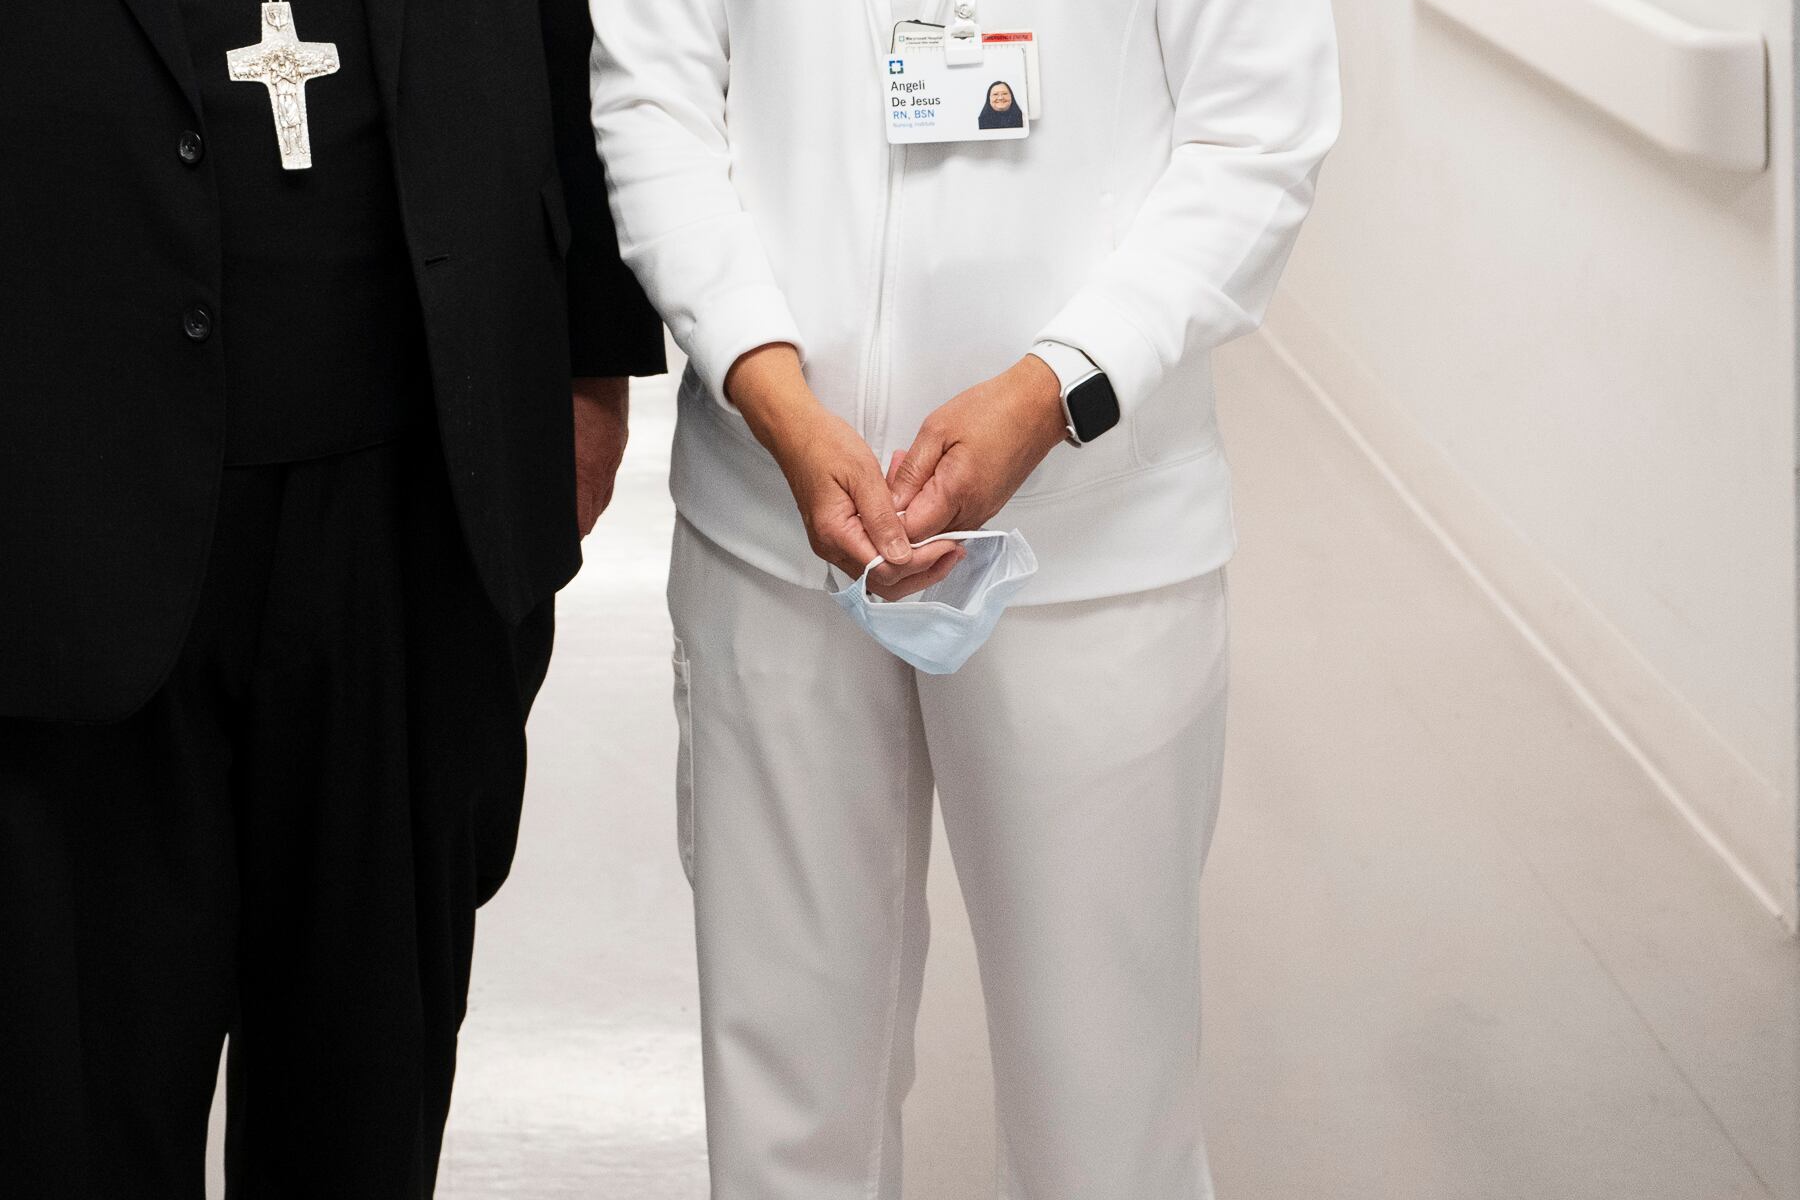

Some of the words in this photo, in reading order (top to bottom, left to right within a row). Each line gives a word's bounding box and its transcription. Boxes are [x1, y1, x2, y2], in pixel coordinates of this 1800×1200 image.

[890, 79, 925, 93] Angeli
[891, 96, 907, 107] De
[910, 96, 941, 106] Jesus
[893, 110, 911, 120] RN,
[914, 109, 935, 119] BSN
